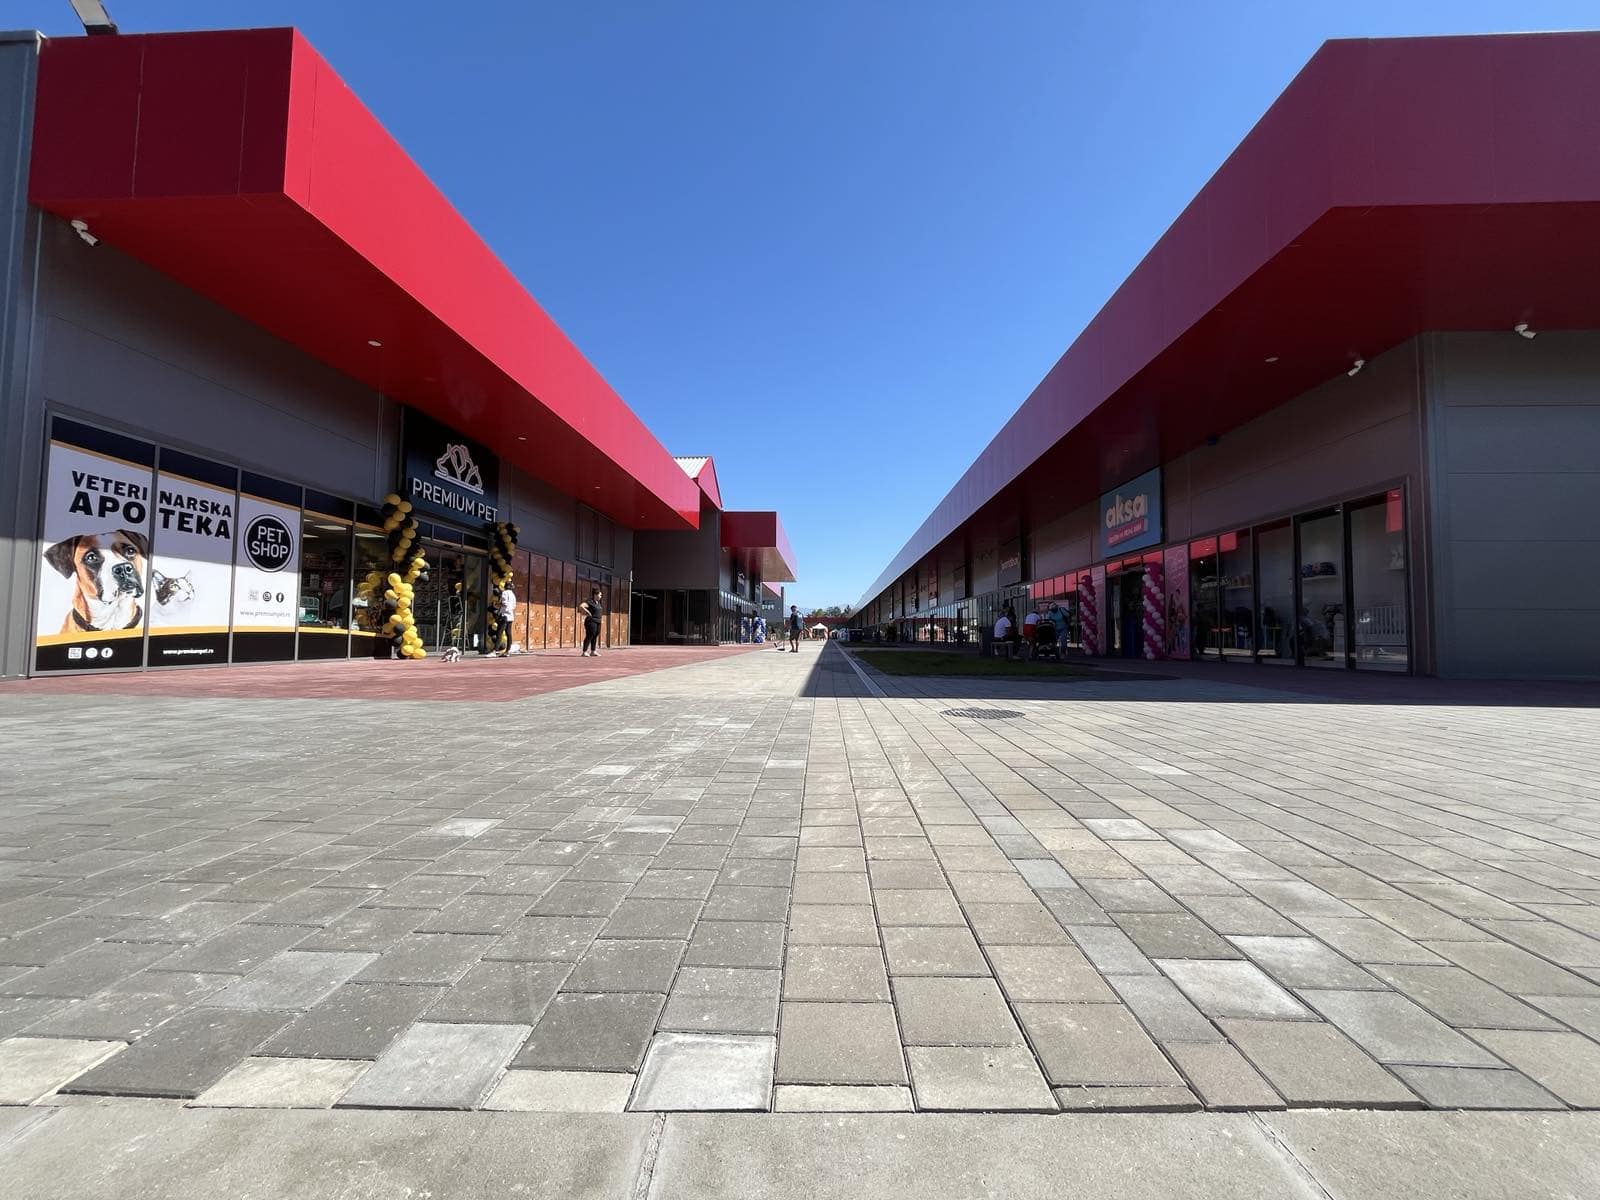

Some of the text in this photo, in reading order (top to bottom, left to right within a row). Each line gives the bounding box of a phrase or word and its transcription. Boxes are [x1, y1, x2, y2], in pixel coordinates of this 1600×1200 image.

[412, 478, 498, 523] PREMIUM PET
[1106, 494, 1146, 529] aksa
[258, 527, 284, 541] PET
[251, 541, 289, 559] SHOP
